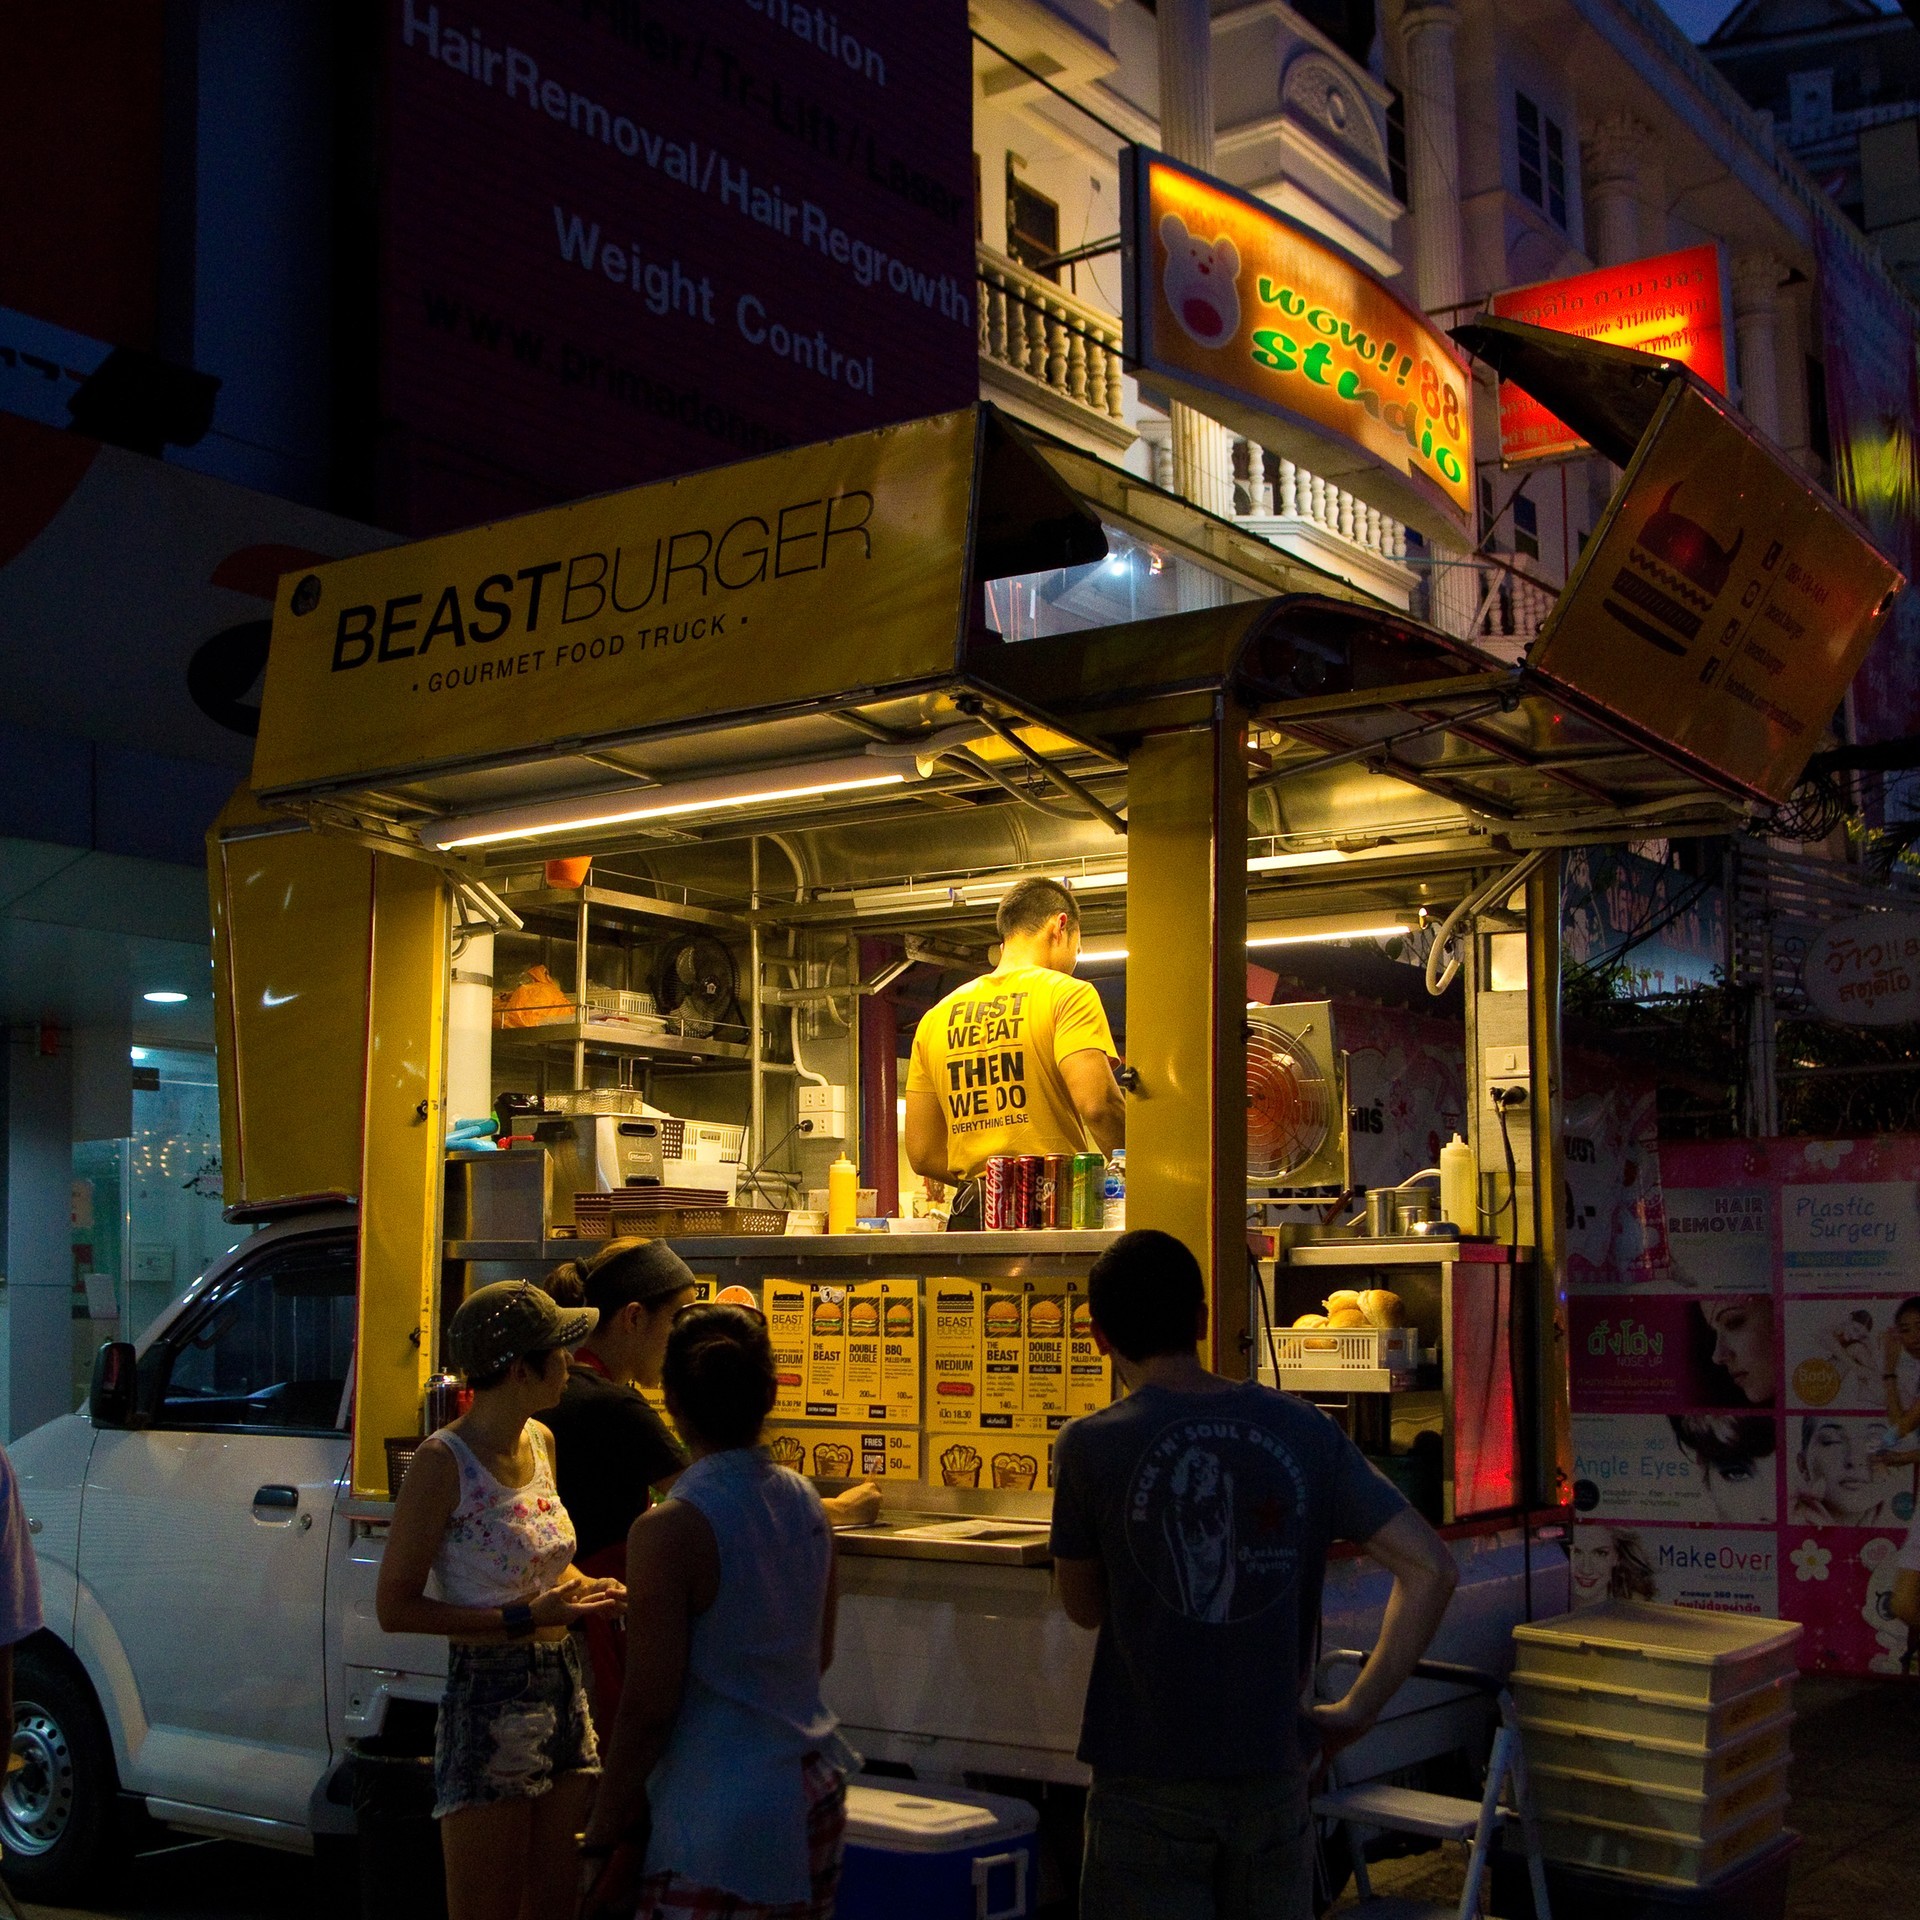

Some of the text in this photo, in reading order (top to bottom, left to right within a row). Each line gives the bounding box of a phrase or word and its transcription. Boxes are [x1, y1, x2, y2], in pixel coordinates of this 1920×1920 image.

[745, 0, 888, 88] nation
[552, 204, 875, 396] Weight Control
[1257, 275, 1413, 387] wow!!
[427, 611, 727, 693] GOURMET FOOD TRUCK
[948, 991, 1029, 1027] FIRST
[947, 1017, 1024, 1050] WE EAT
[947, 1051, 1025, 1091] THEN
[948, 1084, 1028, 1119] WE DO
[952, 1113, 1029, 1135] EVERYTHING ELSE
[1715, 1197, 1763, 1214] HAIR
[1796, 1197, 1875, 1217] Plastic
[1669, 1216, 1765, 1234] REMOVAL
[1810, 1218, 1897, 1242] Surgery
[772, 1314, 803, 1324] BEAST
[937, 1316, 973, 1327] BEAST
[850, 1344, 877, 1353] DOUBLE
[885, 1345, 902, 1355] BBQ
[987, 1350, 1019, 1361] BEAST
[1029, 1342, 1062, 1352] DOUBLE
[1071, 1343, 1091, 1354] BBQ
[813, 1351, 840, 1362] BEAST
[849, 1354, 877, 1363] DOUBLE
[1029, 1353, 1061, 1363] DOUBLE
[936, 1360, 973, 1371] MEDIUM
[953, 1410, 971, 1419] 18.30
[864, 1437, 902, 1448] FRIES 50
[889, 1458, 902, 1468] 50
[1574, 1455, 1690, 1480] Angle Eyes
[1131, 1465, 1160, 1522] ROCK
[1184, 1424, 1239, 1441] SOUL
[1659, 1545, 1772, 1571] MakeOver
